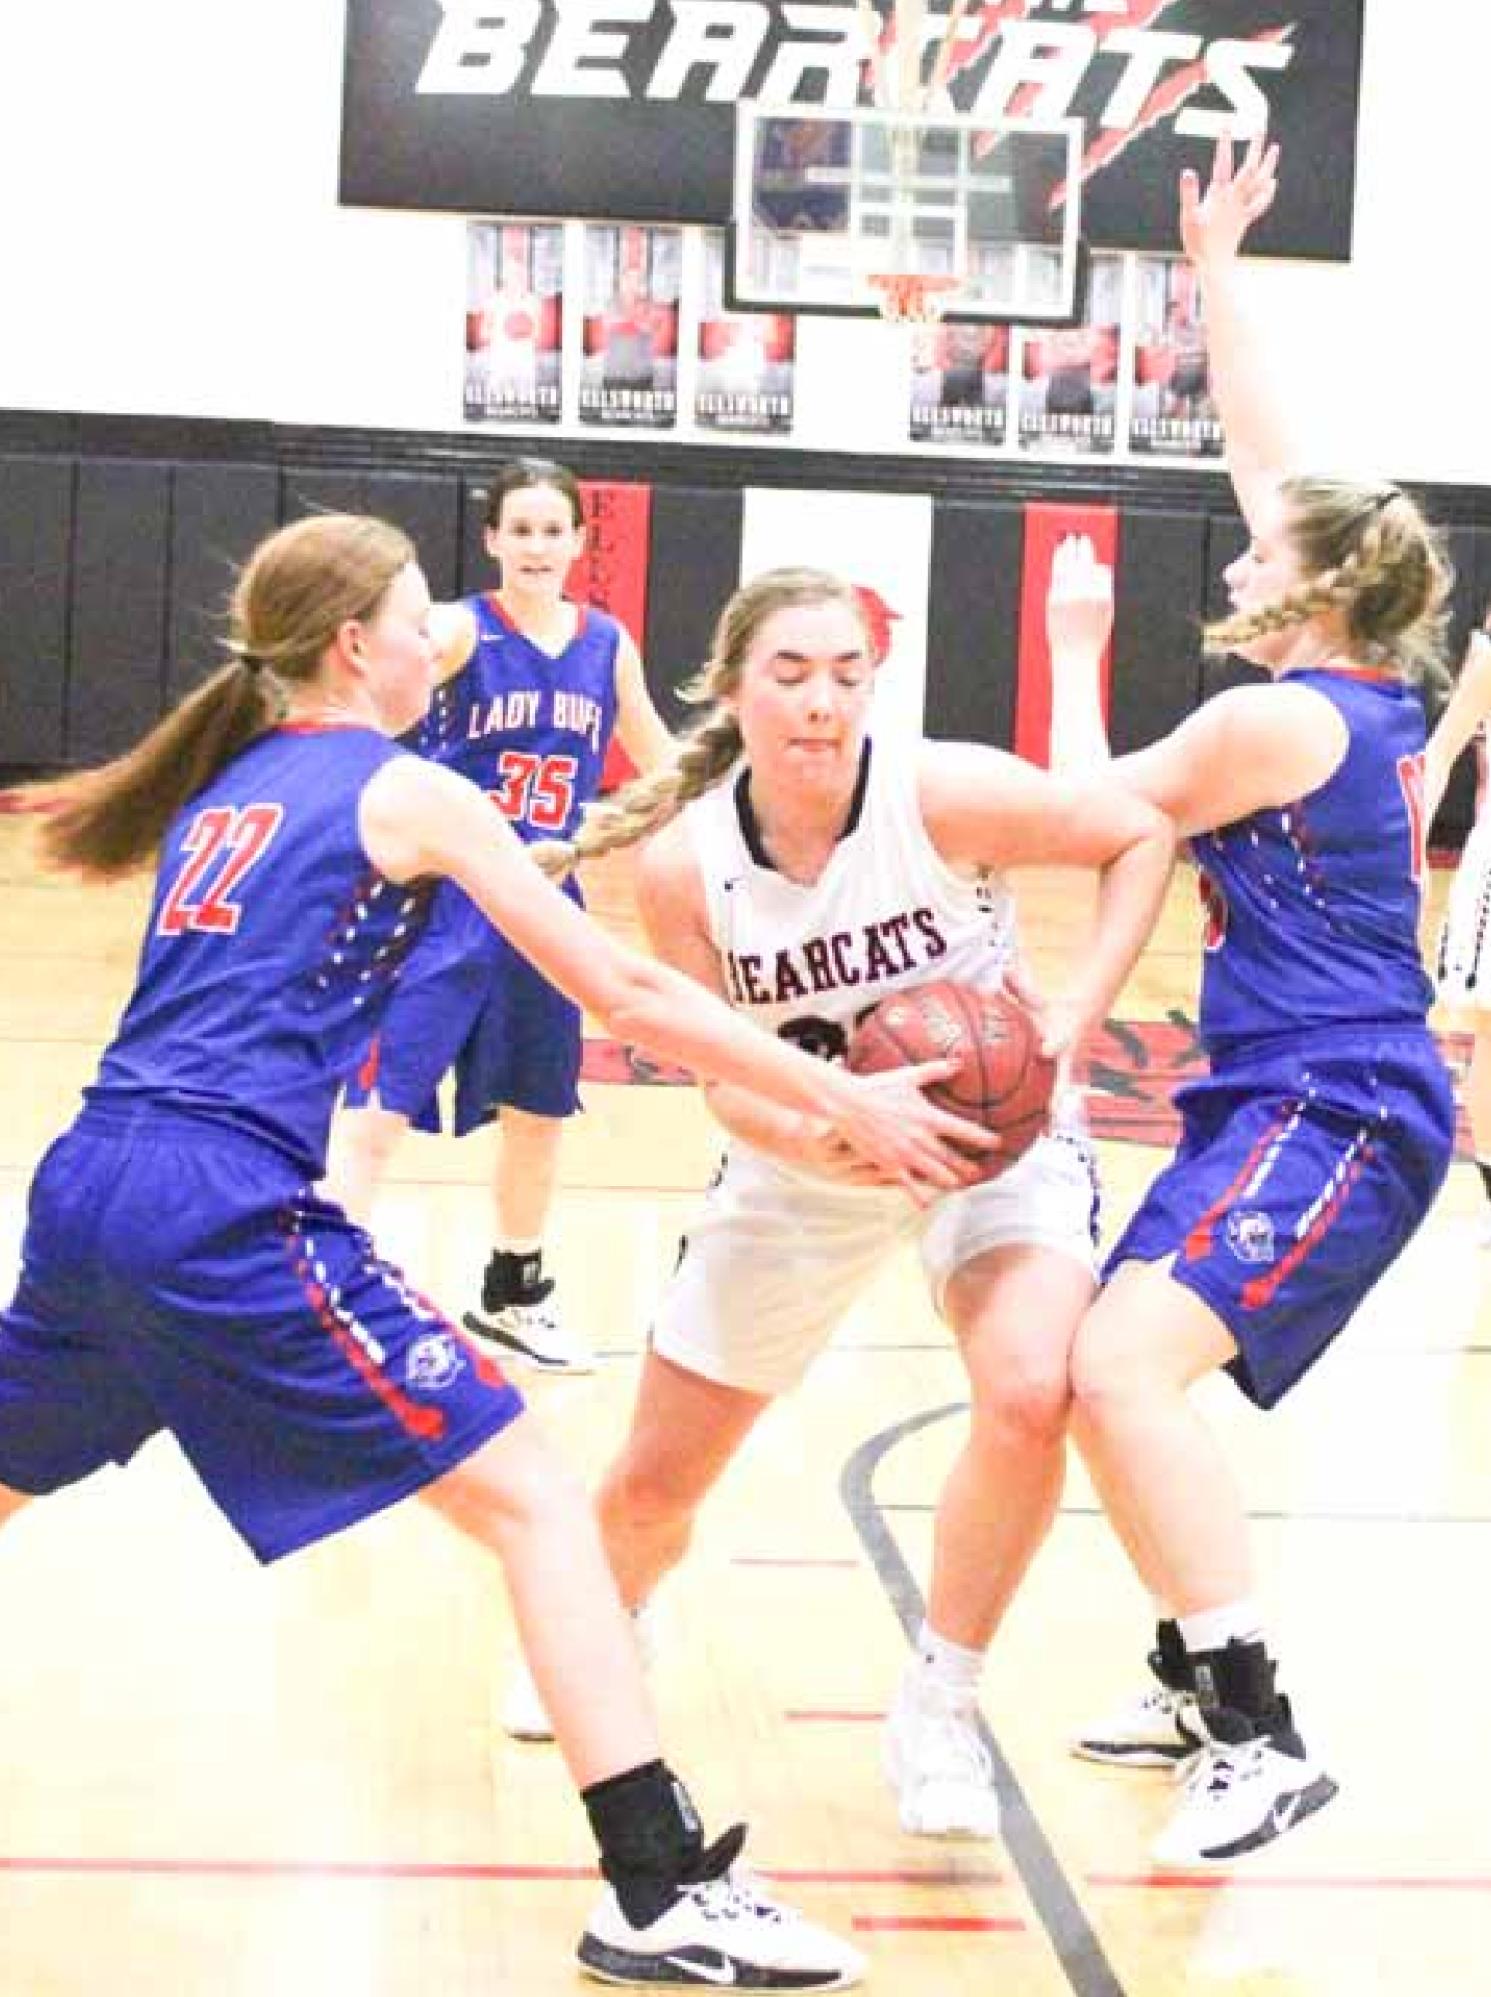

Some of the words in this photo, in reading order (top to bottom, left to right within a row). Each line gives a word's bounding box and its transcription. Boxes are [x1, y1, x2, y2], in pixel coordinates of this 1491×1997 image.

[466, 689, 542, 740] LADY
[489, 750, 579, 831] 35
[155, 802, 284, 936] 22
[727, 907, 948, 1005] EARCATS
